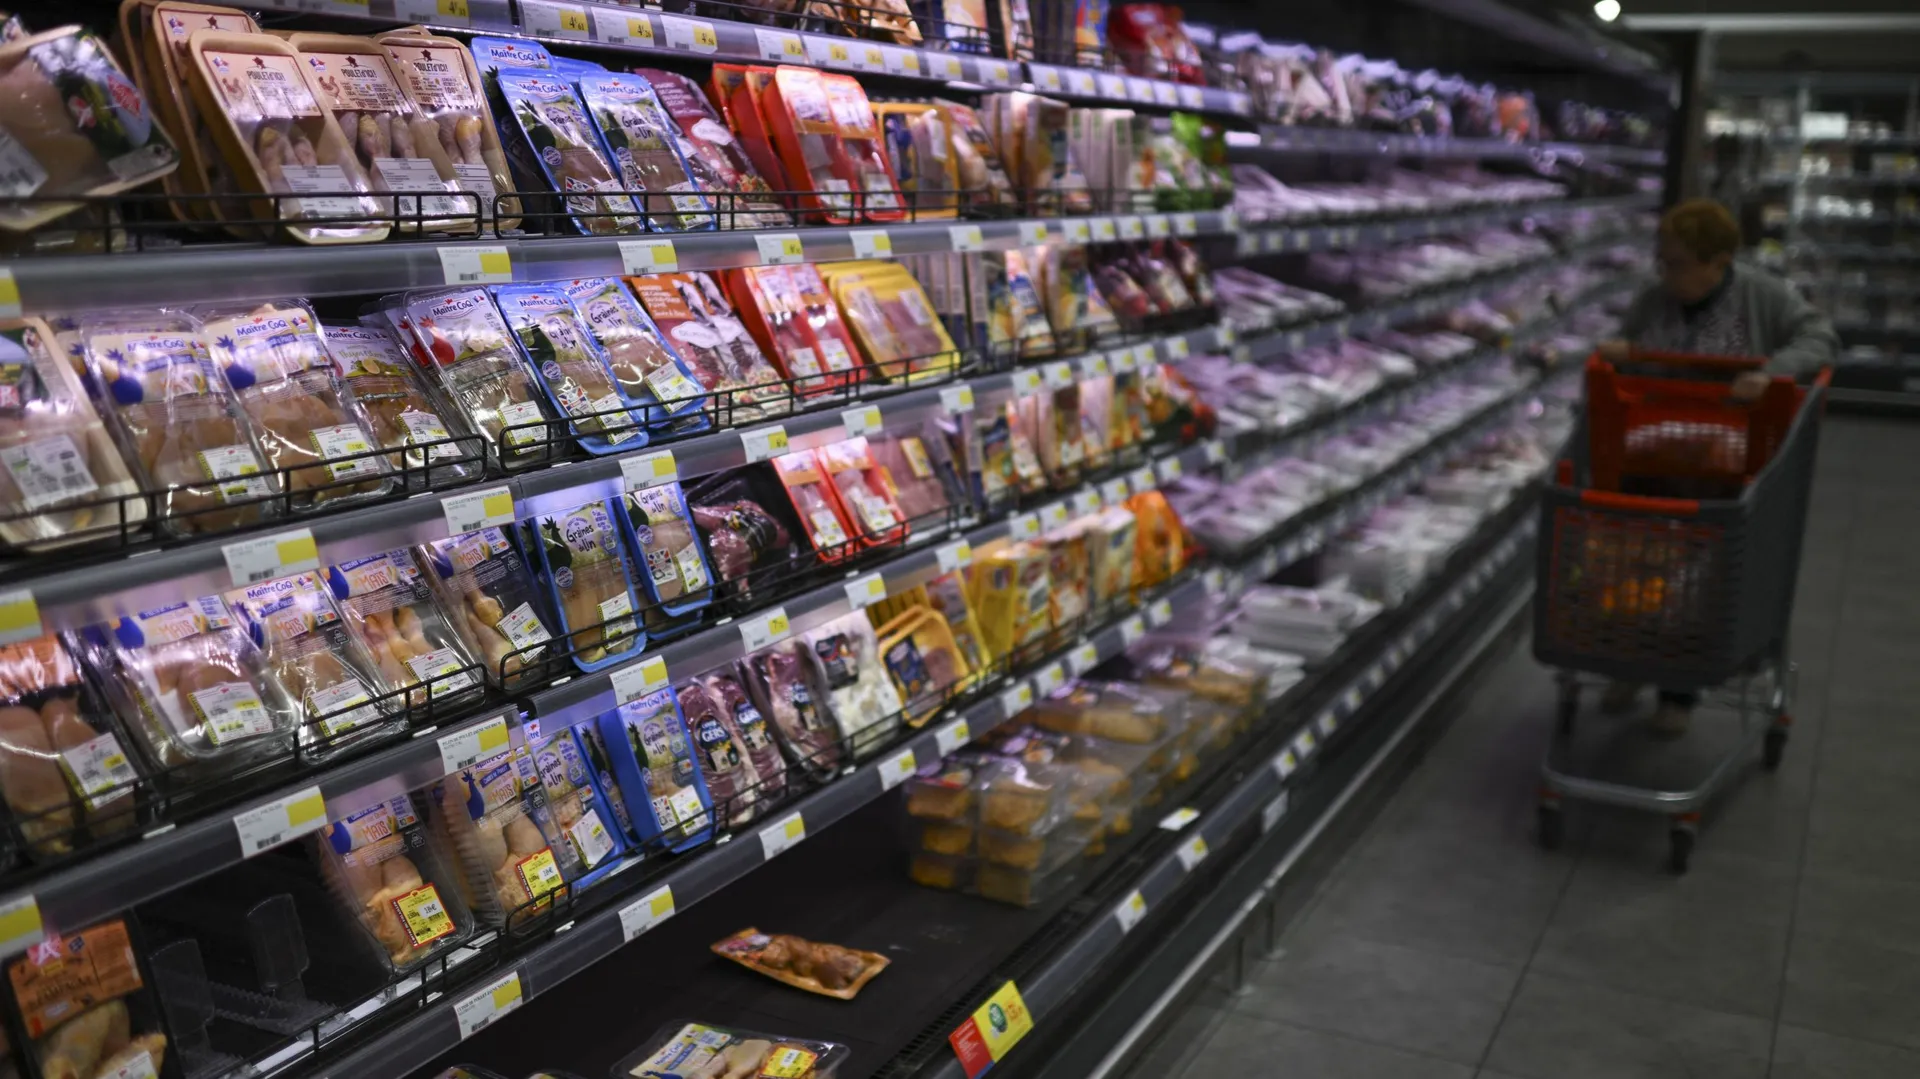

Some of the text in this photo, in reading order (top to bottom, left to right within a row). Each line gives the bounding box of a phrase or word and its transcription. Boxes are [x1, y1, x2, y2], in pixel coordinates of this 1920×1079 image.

[568, 284, 586, 296] aître
[433, 300, 474, 317] Maître CoQ
[236, 319, 288, 336] Maître CoQ
[566, 523, 595, 543] Graines
[582, 539, 597, 552] Lin
[247, 580, 294, 599] Maître CoQ
[541, 758, 562, 778] raines
